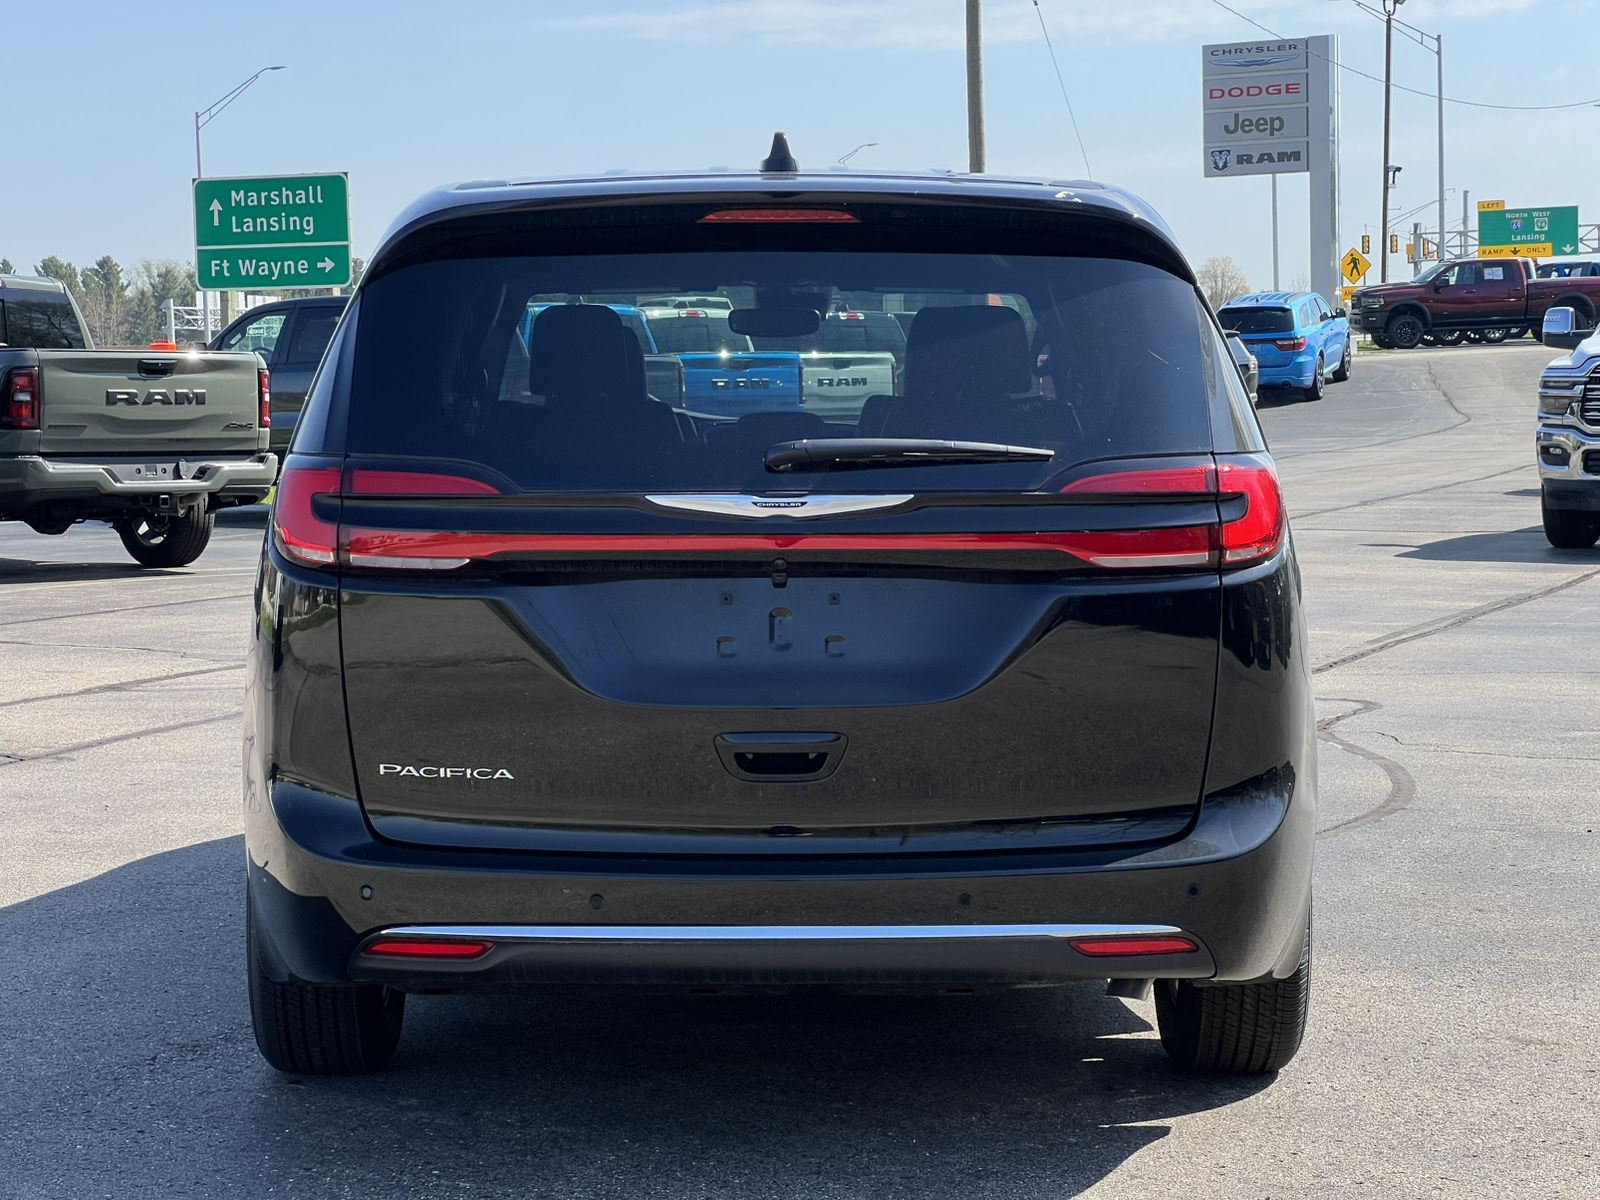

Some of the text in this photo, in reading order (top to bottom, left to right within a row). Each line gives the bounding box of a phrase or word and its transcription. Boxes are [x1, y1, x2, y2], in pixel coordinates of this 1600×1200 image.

[1210, 44, 1298, 57] CHRYSLER
[1209, 82, 1301, 100] DODGE
[1223, 113, 1285, 137] Jeep
[1236, 150, 1301, 165] RAM
[230, 185, 323, 207] Marshall
[231, 212, 315, 235] Lansing
[1537, 220, 1546, 228] 94
[1511, 233, 1545, 241] Lansing
[1526, 246, 1547, 254] ONLY
[210, 258, 309, 281] Ft Wayne
[711, 378, 770, 391] RAM
[817, 377, 868, 388] RAM
[105, 388, 207, 407] RAM
[379, 763, 515, 780] PACIFICA
